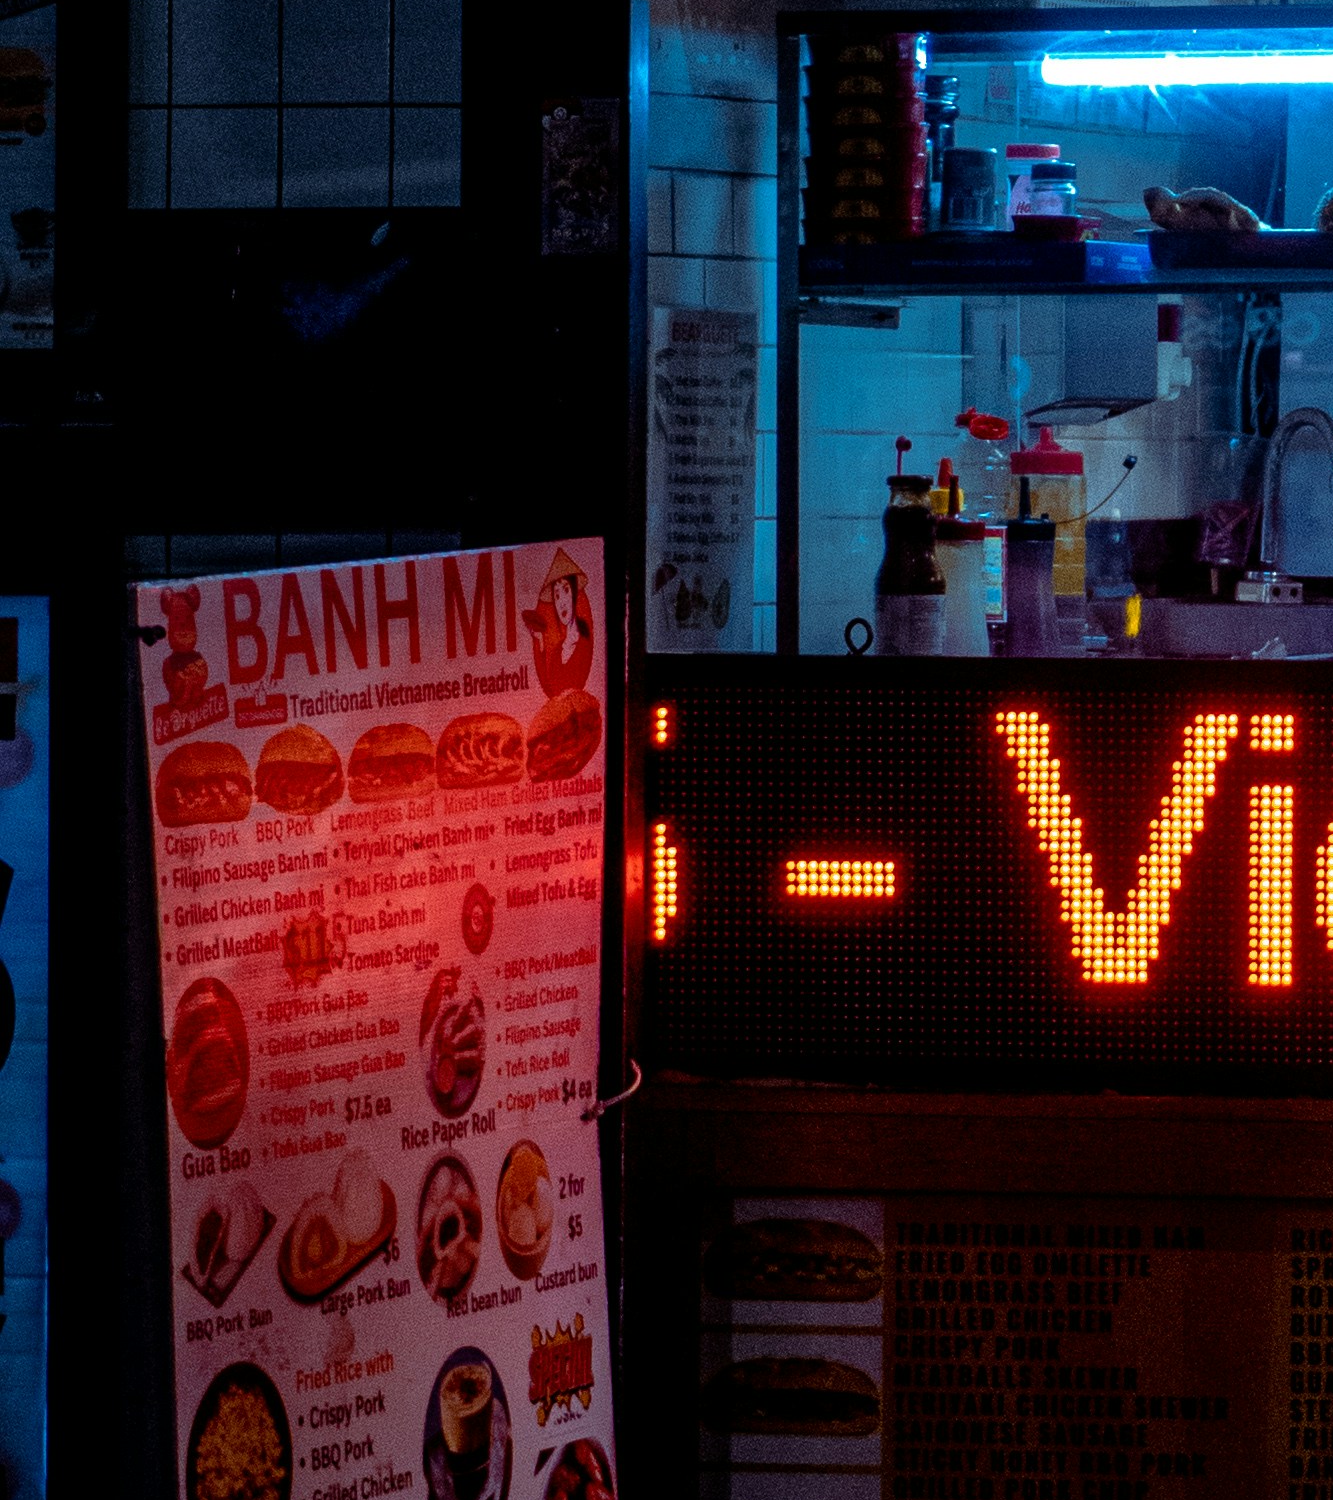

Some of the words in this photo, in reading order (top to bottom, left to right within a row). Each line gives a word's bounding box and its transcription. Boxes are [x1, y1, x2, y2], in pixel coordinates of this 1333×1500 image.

[222, 560, 421, 686] BANH
[443, 551, 518, 660] MI
[290, 692, 373, 720] Traditional
[375, 679, 460, 707] Vietnamese
[463, 666, 529, 698] Breadroll
